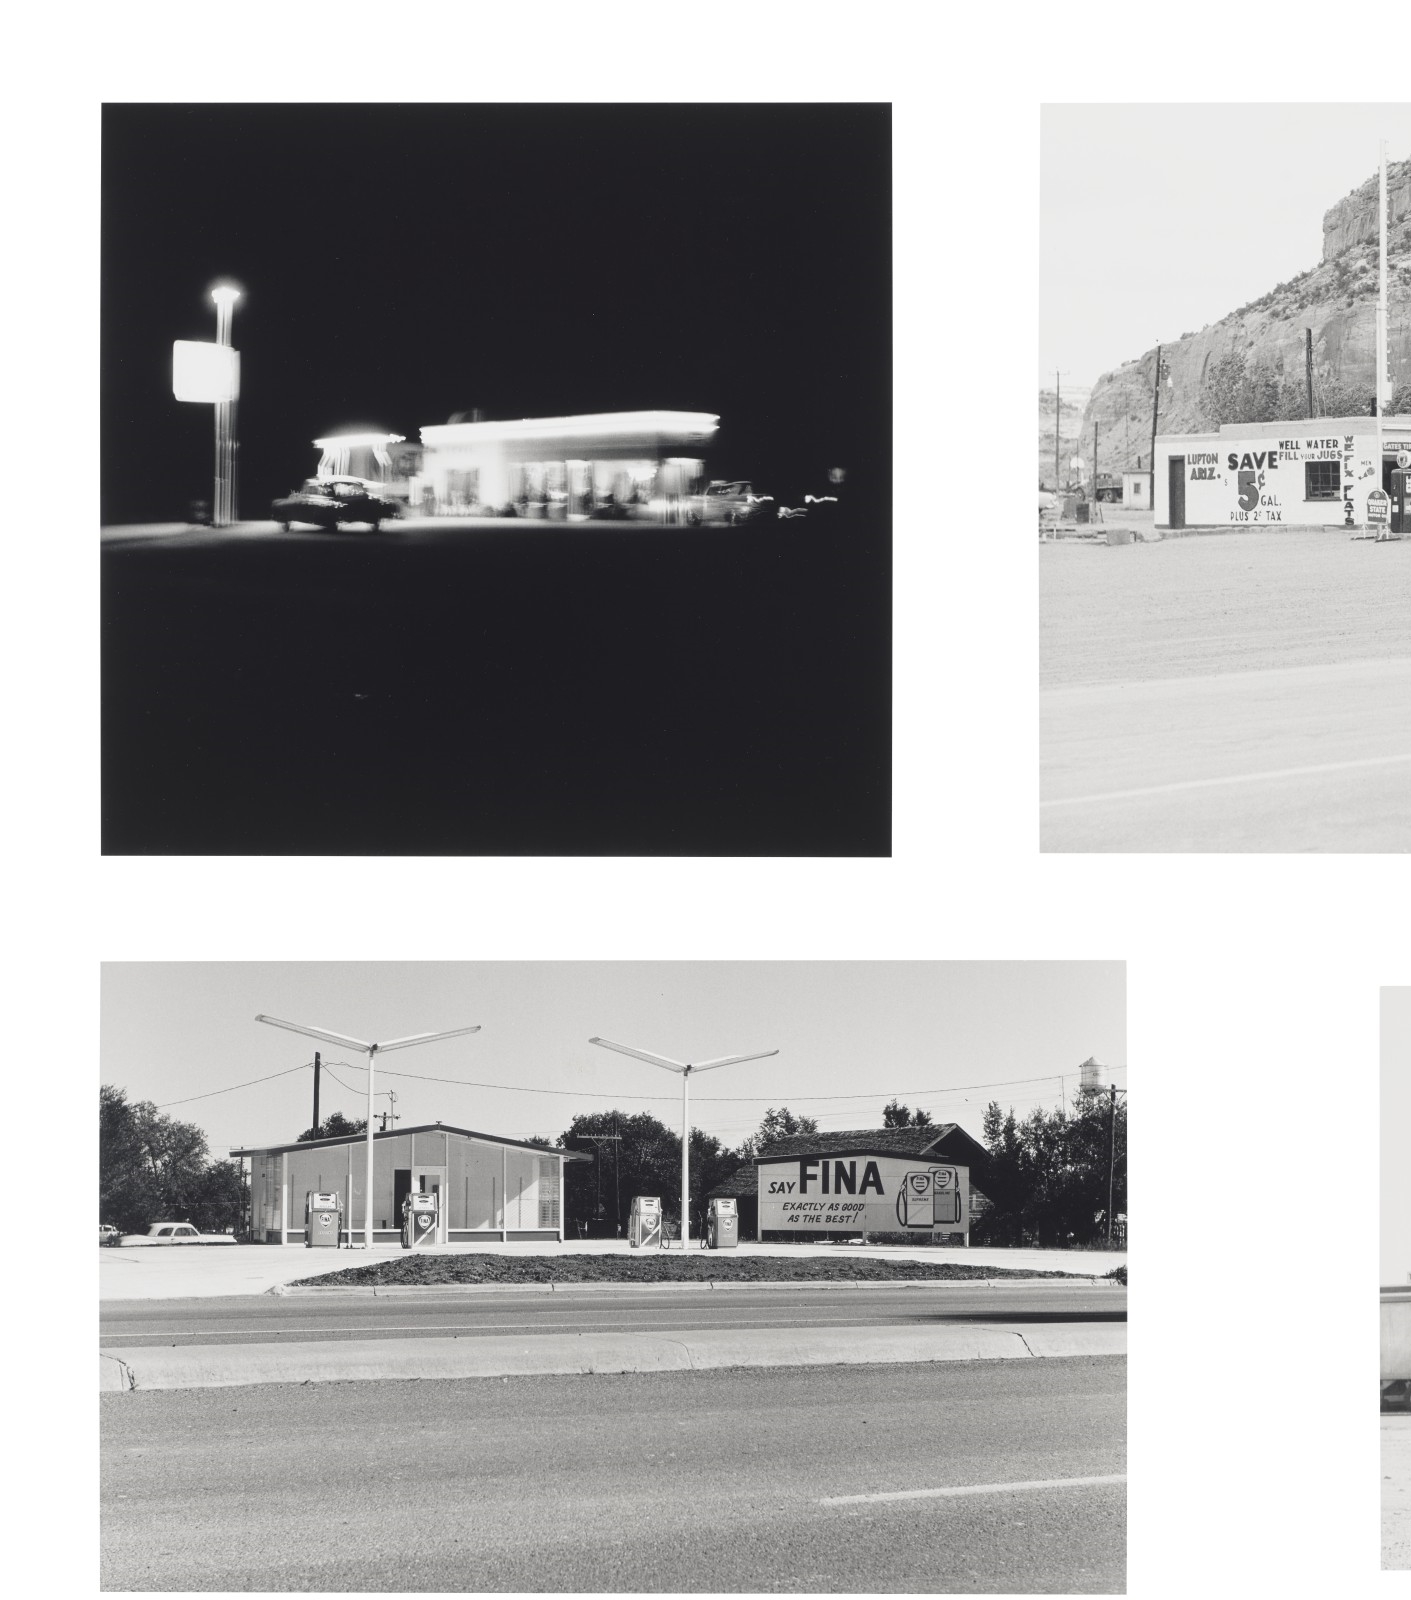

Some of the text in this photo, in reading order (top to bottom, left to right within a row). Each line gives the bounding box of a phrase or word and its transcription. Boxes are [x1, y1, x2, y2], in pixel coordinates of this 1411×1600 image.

[1278, 438, 1339, 451] WELL WATER
[1383, 443, 1402, 451] GATES
[1187, 452, 1219, 466] LUPTON
[1227, 450, 1279, 471] SAVE
[1278, 452, 1299, 461] FILL
[1316, 449, 1344, 461] JUGS
[1190, 467, 1222, 481] ARIZ.
[1260, 494, 1283, 507] GAL.
[1230, 510, 1283, 522] PLUS TAX
[799, 1160, 885, 1196] FINA
[768, 1181, 796, 1194] SAY
[782, 1202, 865, 1212] EXACTLY AS GOOD
[787, 1210, 859, 1224] AS THE BEST!
